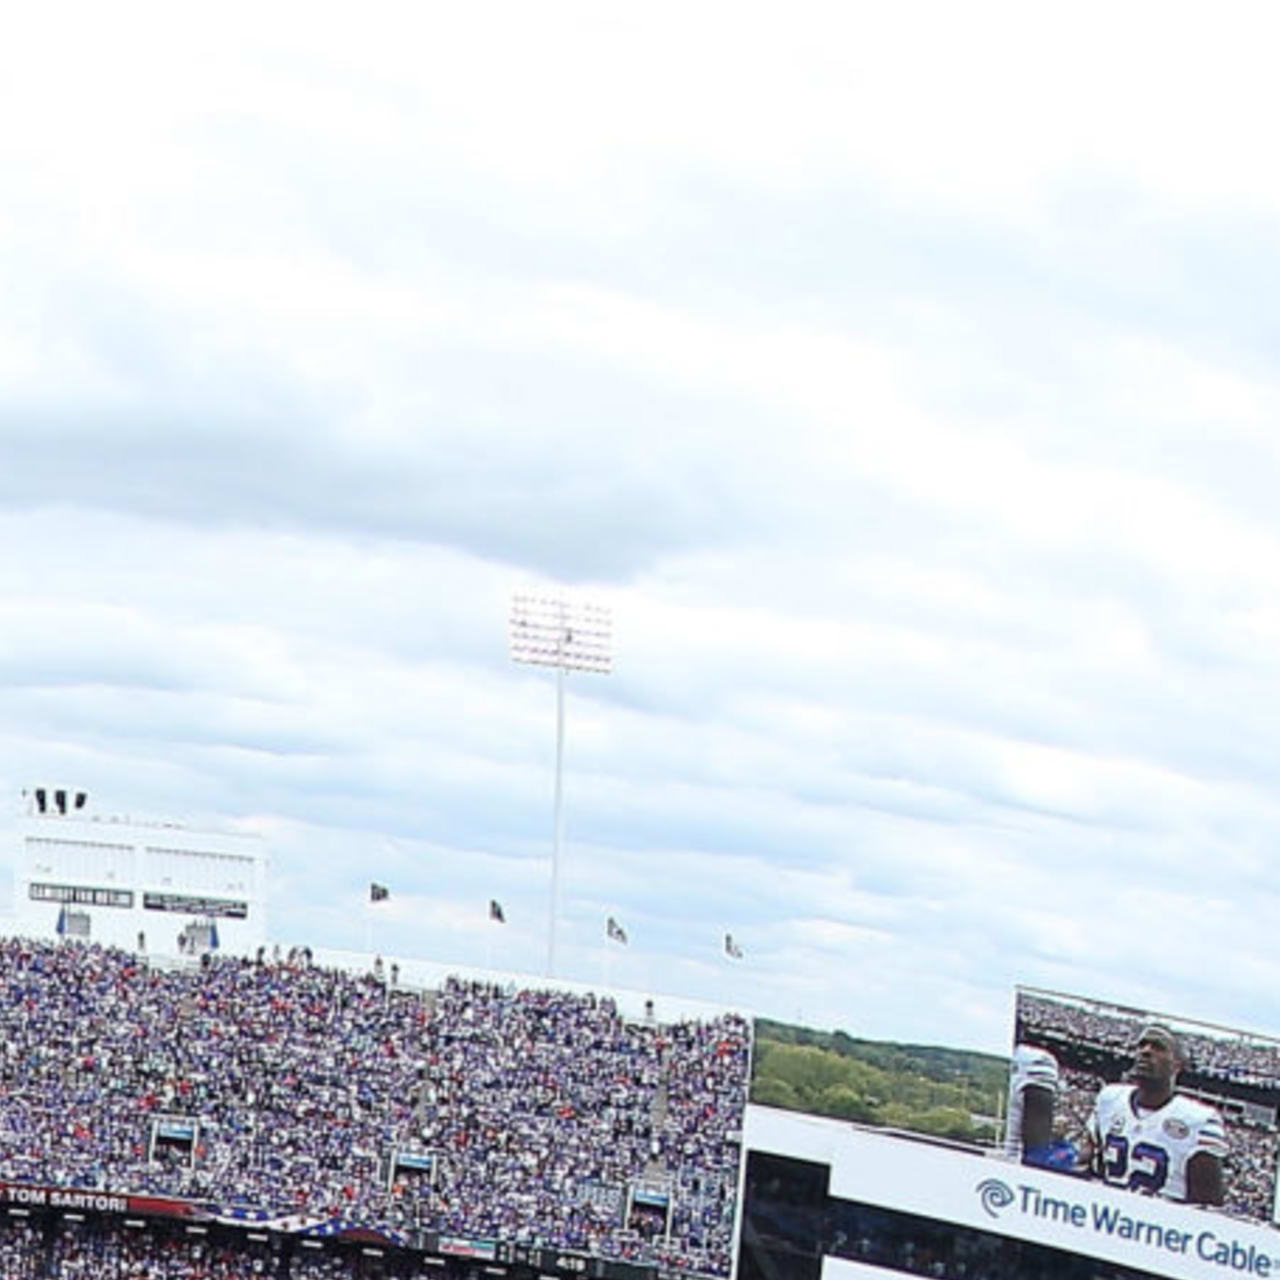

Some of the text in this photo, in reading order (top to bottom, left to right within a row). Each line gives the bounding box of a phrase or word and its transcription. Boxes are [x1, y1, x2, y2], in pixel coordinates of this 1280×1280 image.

[7, 1188, 46, 1204] TOM
[1018, 1183, 1272, 1278] Time Warner Cable
